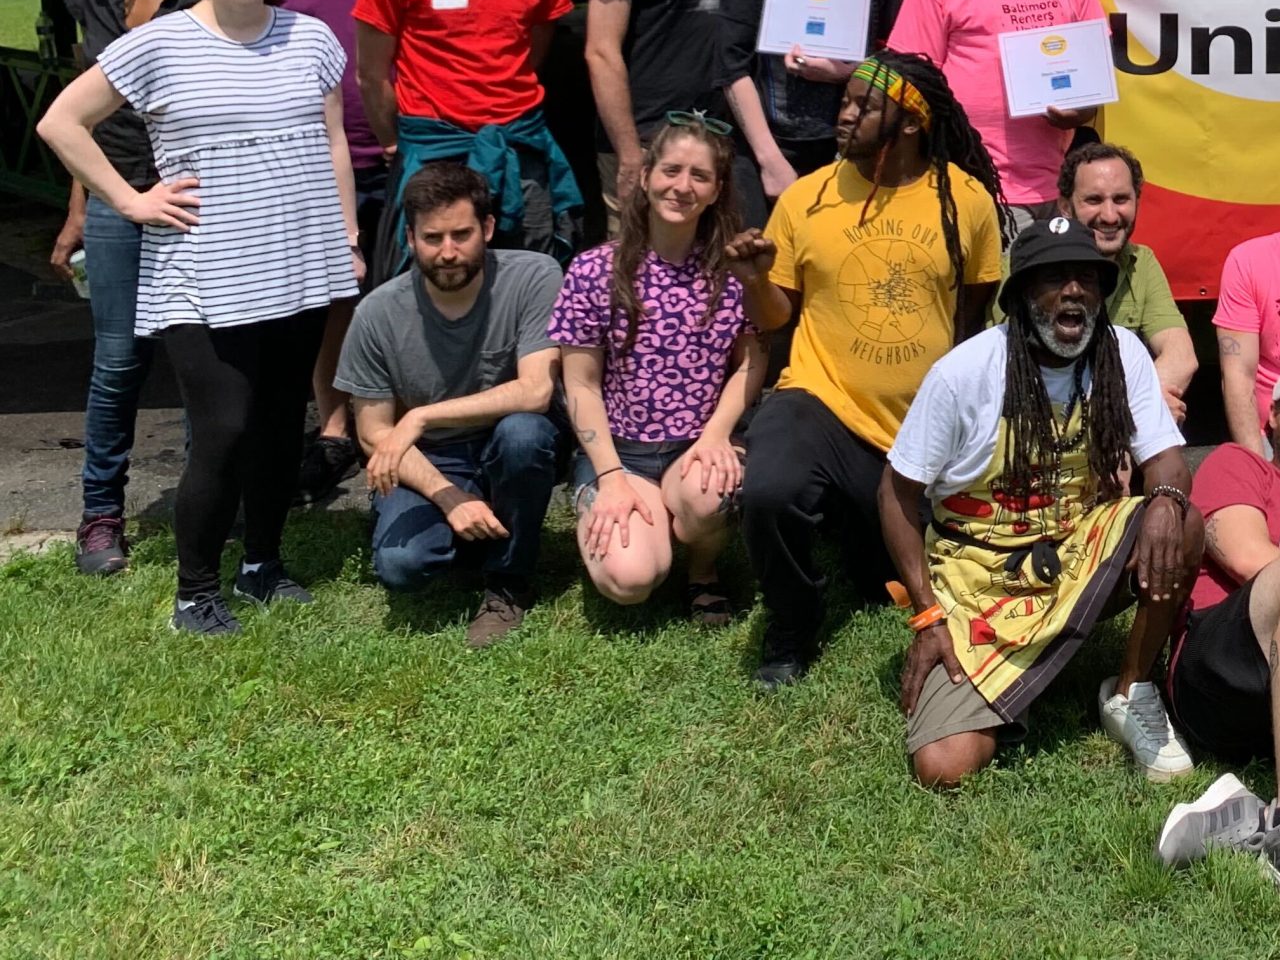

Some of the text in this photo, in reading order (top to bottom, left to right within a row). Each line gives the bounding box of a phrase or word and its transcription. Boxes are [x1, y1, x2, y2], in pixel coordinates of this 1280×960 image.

[1002, 0, 1059, 14] Baltimore
[1010, 11, 1055, 25] Renters
[842, 218, 938, 249] HOUSING OUR
[850, 337, 926, 366] NEIGHBORS
